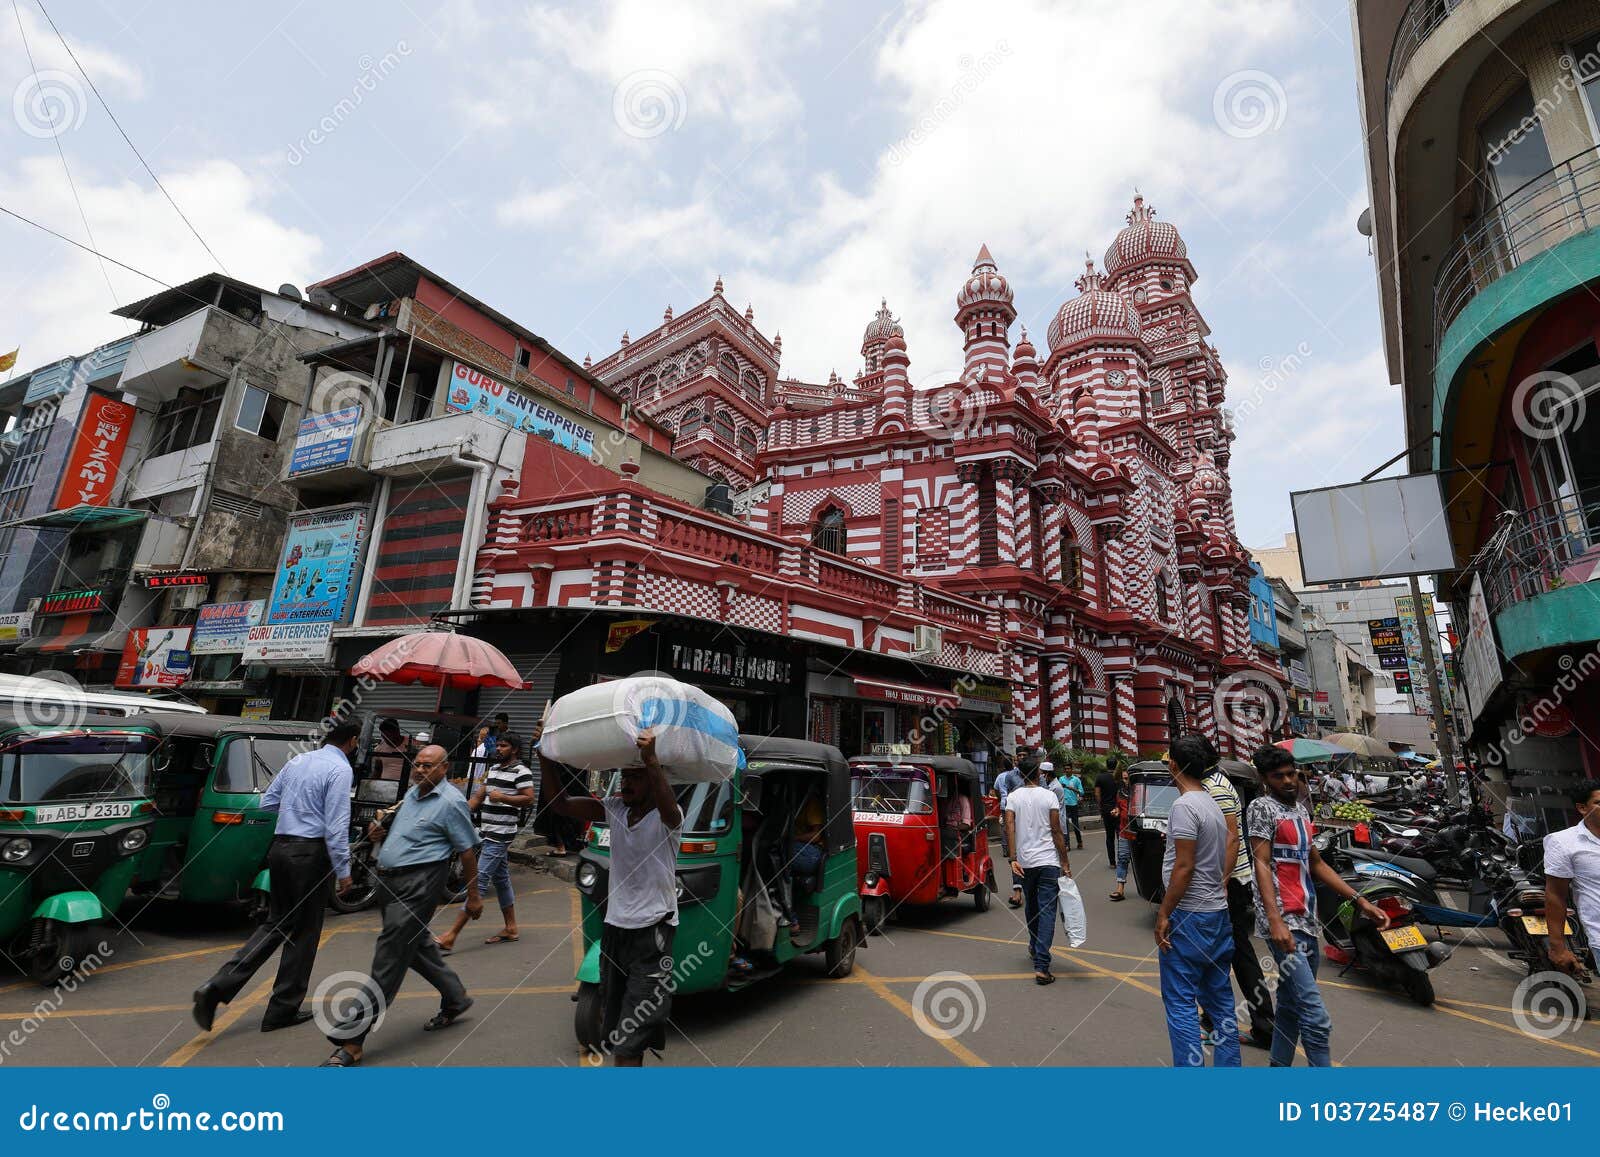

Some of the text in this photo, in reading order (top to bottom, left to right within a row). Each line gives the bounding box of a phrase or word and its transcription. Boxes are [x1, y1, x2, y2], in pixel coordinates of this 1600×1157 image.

[455, 364, 504, 397] GURU
[98, 421, 120, 433] NEW
[290, 608, 334, 619] ENTERPRISES
[248, 626, 273, 641] GURU
[272, 623, 330, 640] ENTERPRISES
[746, 656, 791, 684] HOUSE
[56, 806, 88, 821] ABJ
[94, 804, 130, 817] 2319
